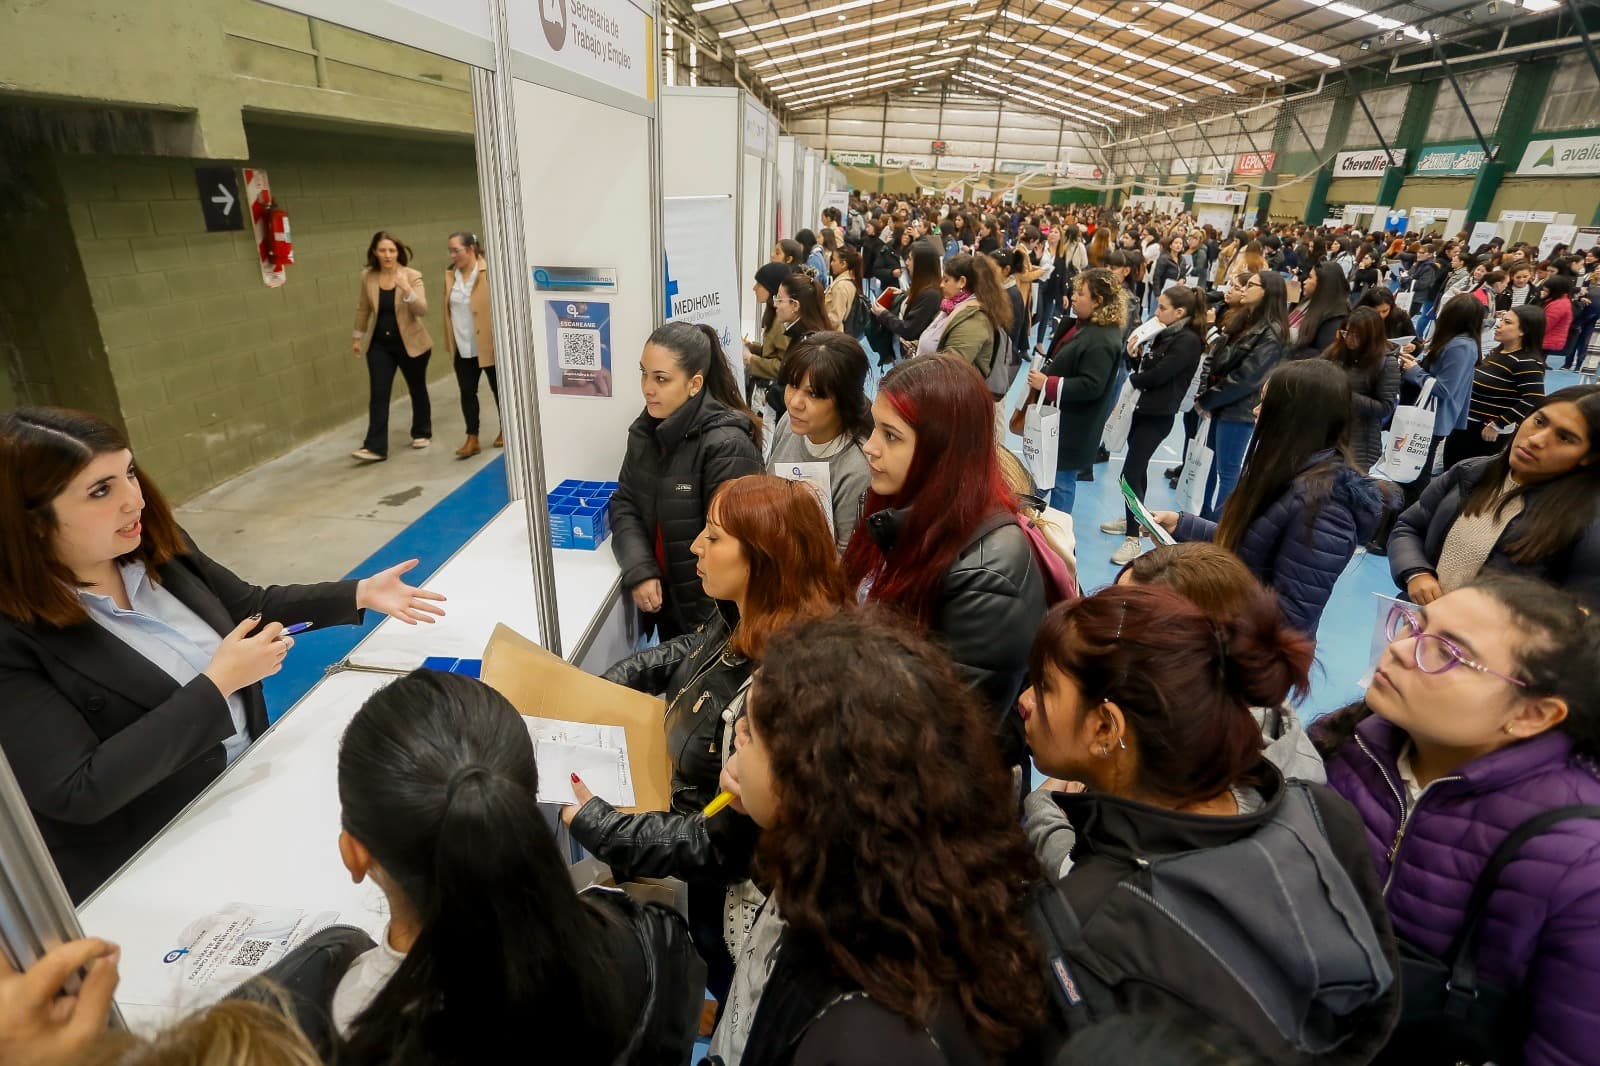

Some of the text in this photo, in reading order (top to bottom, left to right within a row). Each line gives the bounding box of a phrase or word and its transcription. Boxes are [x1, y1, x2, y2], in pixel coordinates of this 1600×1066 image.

[610, 16, 619, 39] de
[571, 23, 631, 69] Trabajo y Empleo
[674, 291, 721, 317] MEDIHOME
[192, 941, 213, 966] SUMATE
[211, 931, 222, 943] AL
[188, 956, 210, 981] EQUIPO
